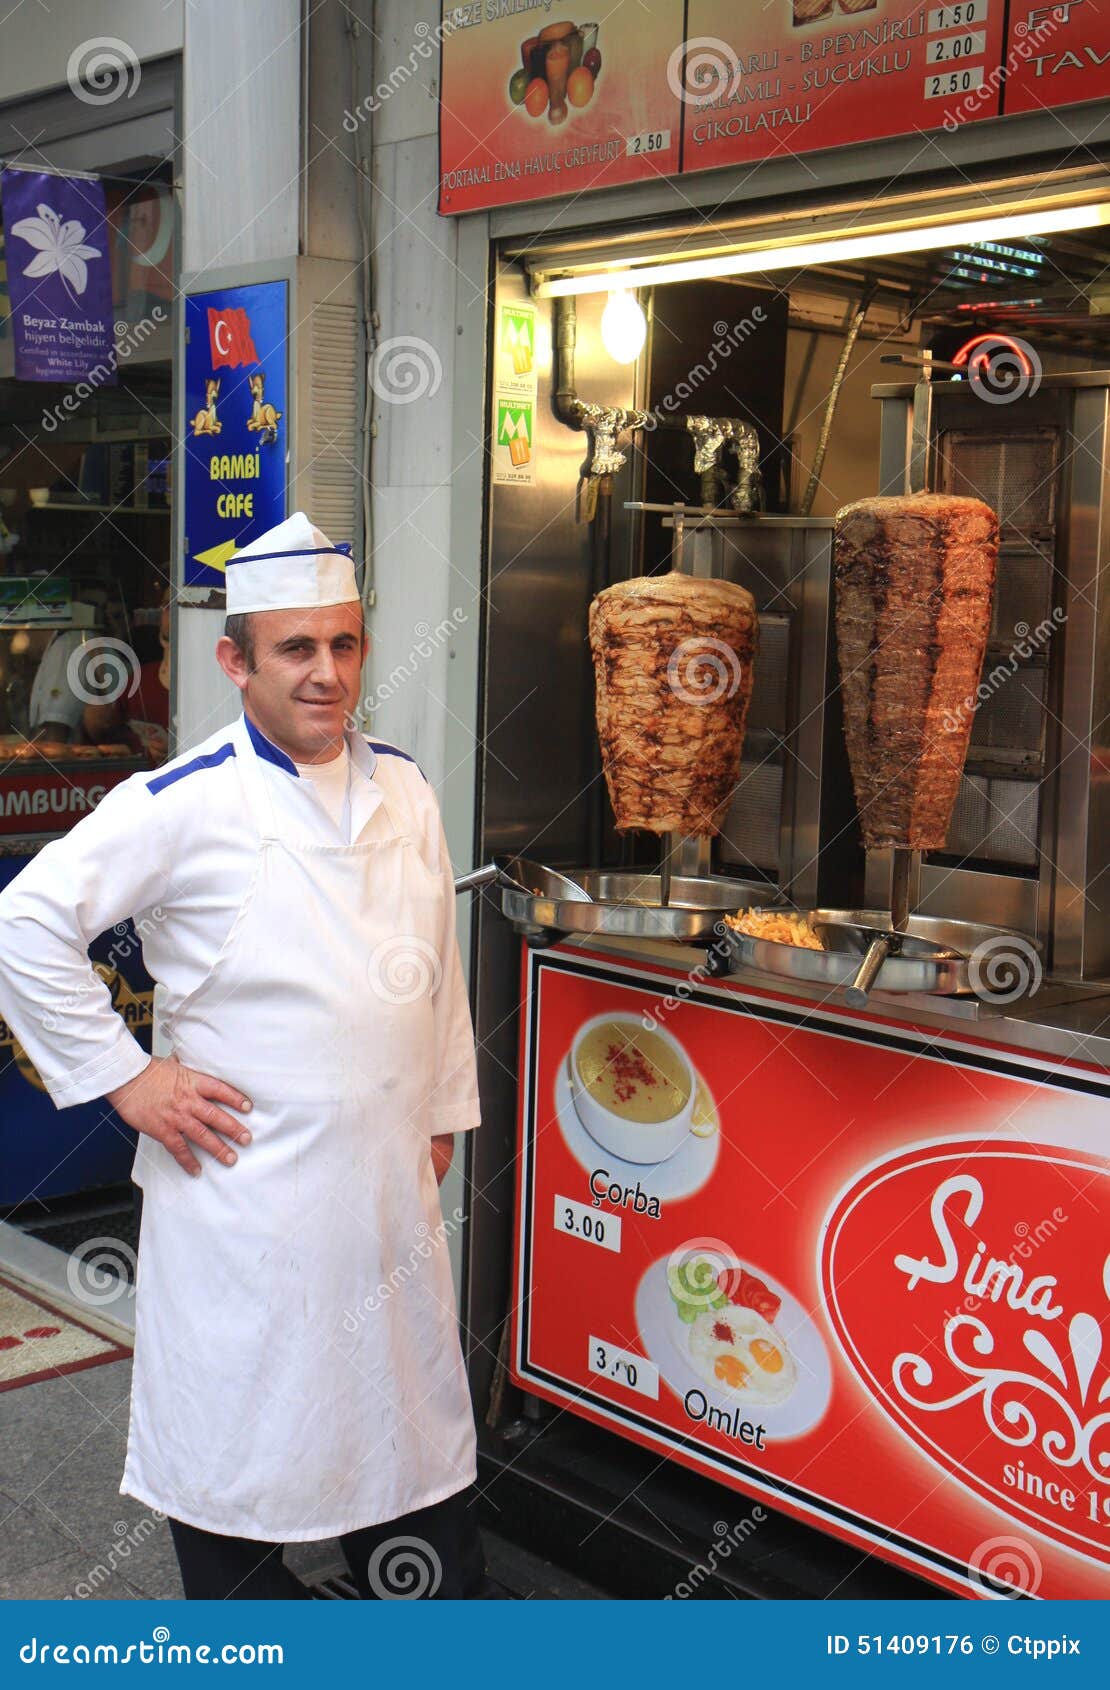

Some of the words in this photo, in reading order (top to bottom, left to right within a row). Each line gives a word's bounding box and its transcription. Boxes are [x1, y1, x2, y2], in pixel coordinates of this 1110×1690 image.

[937, 3, 975, 28] 1.50
[1028, 0, 1085, 31] ET
[935, 37, 973, 61] 2.00
[802, 49, 912, 91] SUCUKLU
[932, 71, 970, 96] 2.50
[692, 103, 811, 146] ÇİKOLATALI
[633, 133, 663, 154] 2.50
[442, 168, 491, 191] PORTAKAL
[525, 150, 561, 174] HAVUÇ
[564, 139, 621, 168] GREYFURT
[23, 314, 57, 330] Beyaz
[60, 317, 105, 332] Zambak
[24, 330, 56, 344] hijyen
[48, 357, 73, 367] White
[74, 360, 89, 369] Lily
[216, 493, 254, 518] CAFE
[589, 1168, 661, 1219] Çorba
[565, 1208, 605, 1242] 3.00
[596, 1346, 637, 1387] 3.0
[684, 1388, 766, 1450] Omlet
[1003, 1460, 1076, 1511] since
